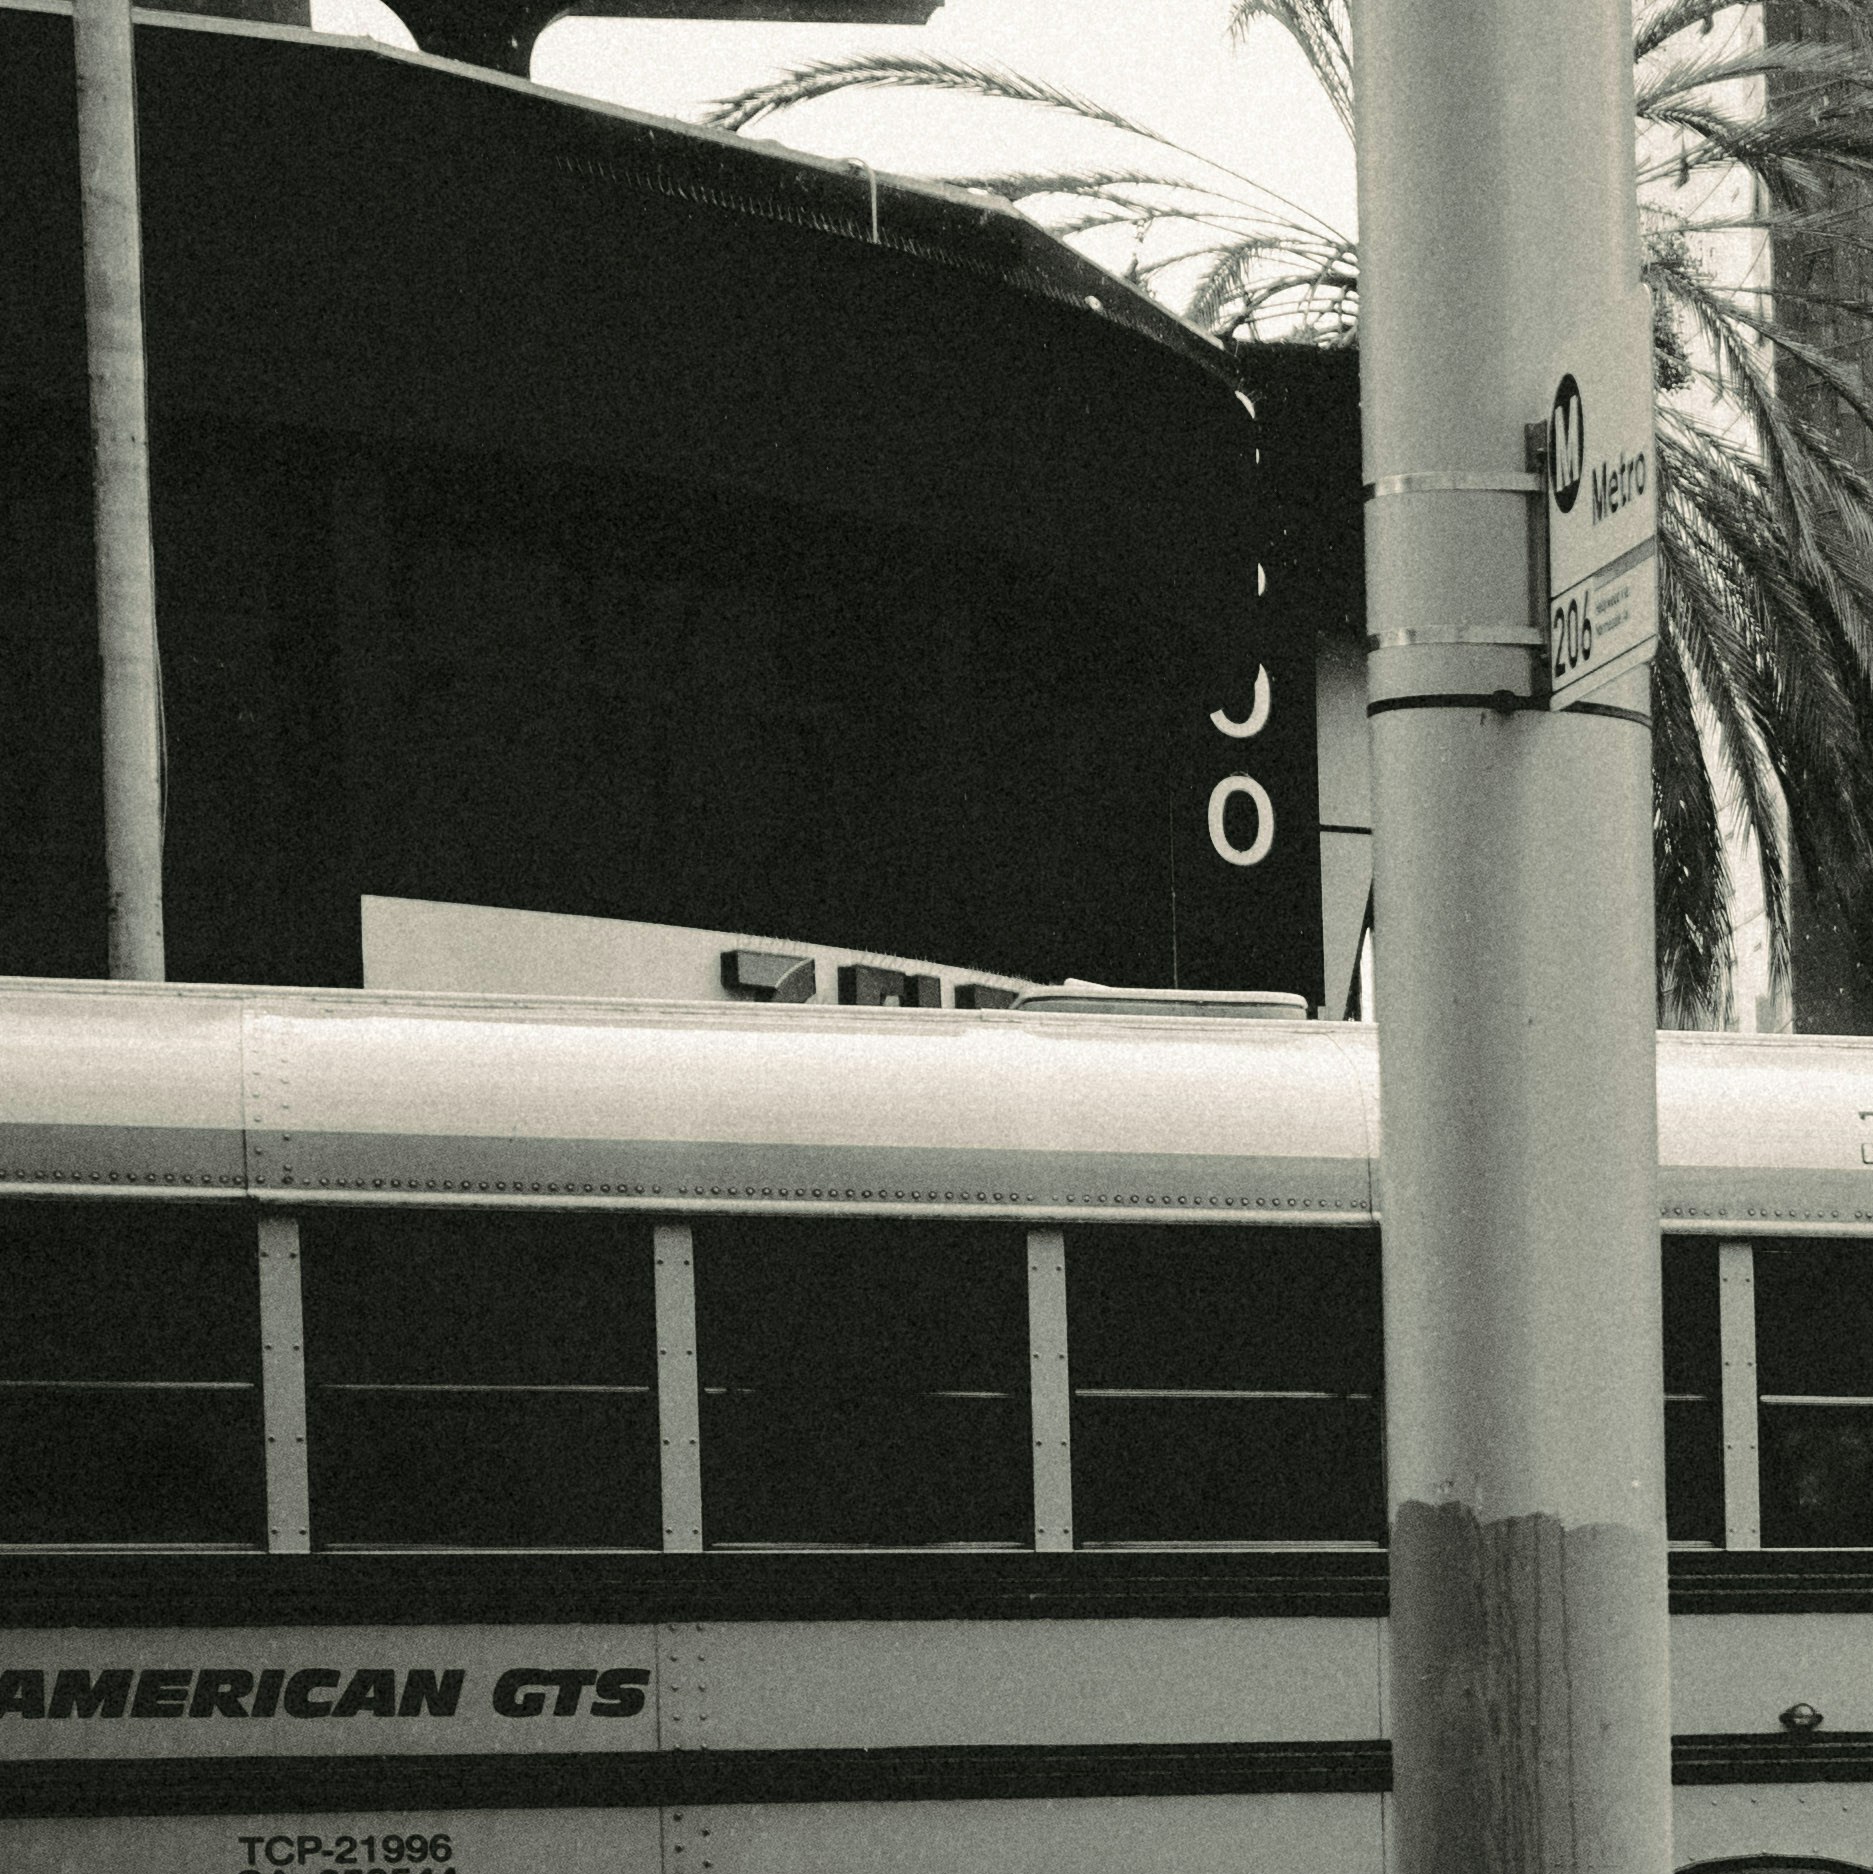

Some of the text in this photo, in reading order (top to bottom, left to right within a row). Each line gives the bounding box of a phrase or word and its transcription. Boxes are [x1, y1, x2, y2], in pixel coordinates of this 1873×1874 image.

[1592, 451, 1646, 526] Metro
[1553, 590, 1592, 678] 206
[0, 1667, 652, 1719] AMERICAN GTS
[238, 1833, 453, 1866] TCP-21996
